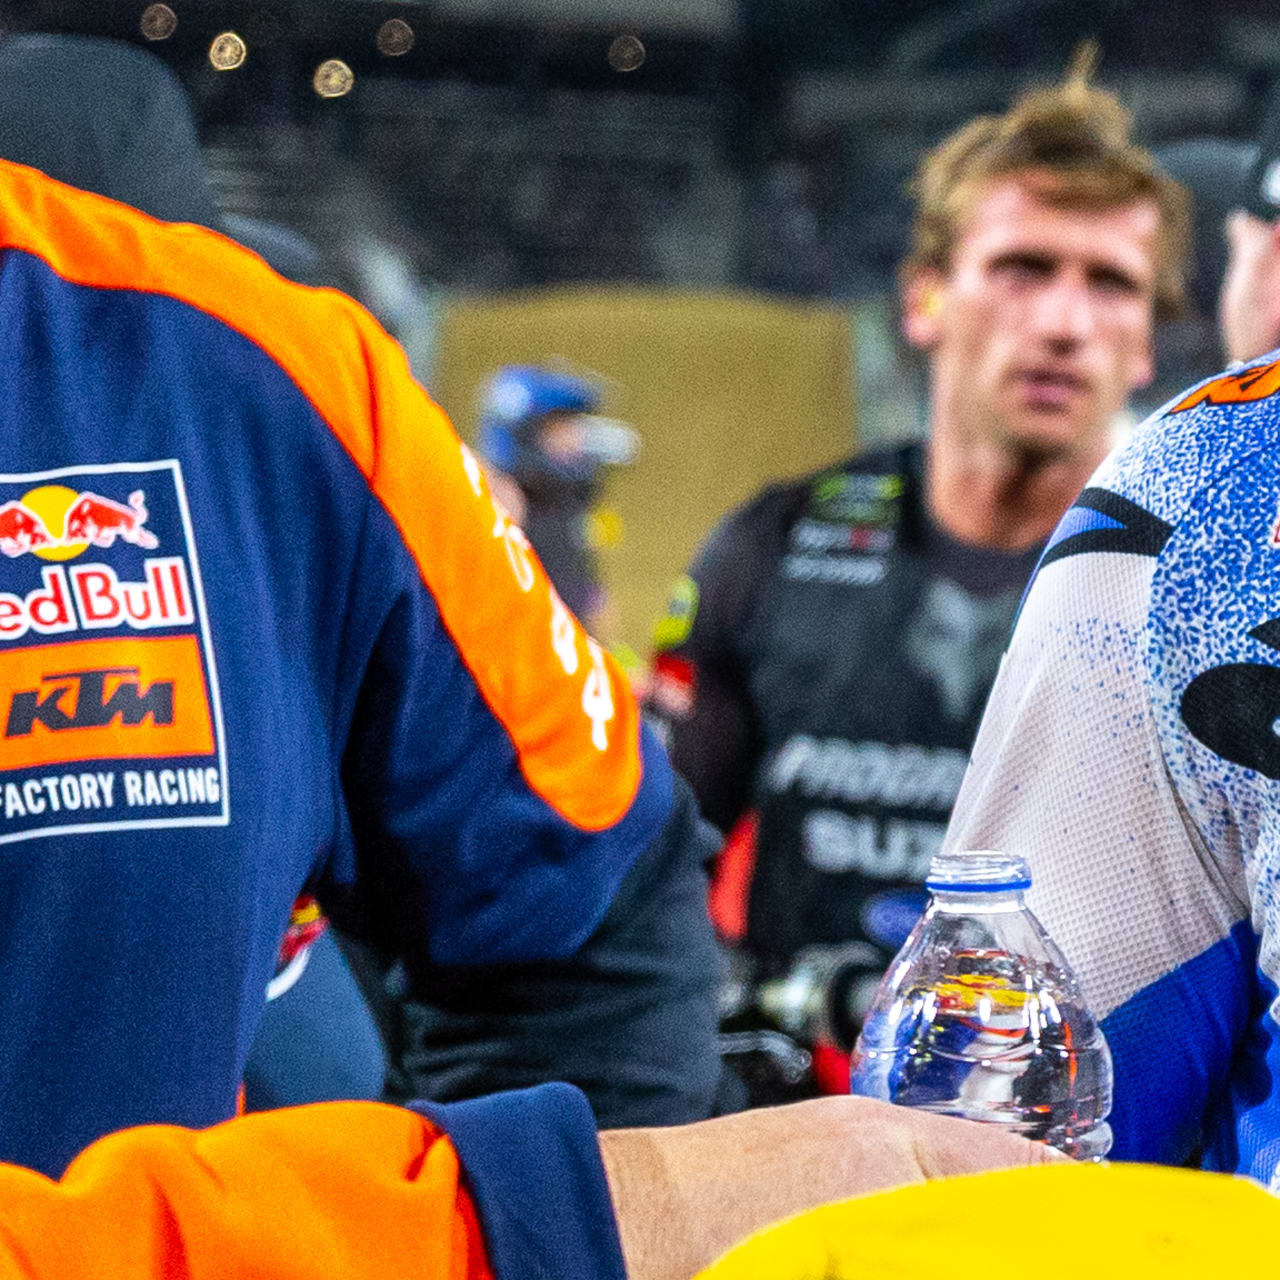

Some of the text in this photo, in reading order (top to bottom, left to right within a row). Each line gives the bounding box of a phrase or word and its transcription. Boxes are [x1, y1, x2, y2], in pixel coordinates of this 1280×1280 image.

[0, 561, 190, 634] ed Bull
[5, 668, 174, 737] KTM
[0, 766, 220, 819] ACTORY RACING
